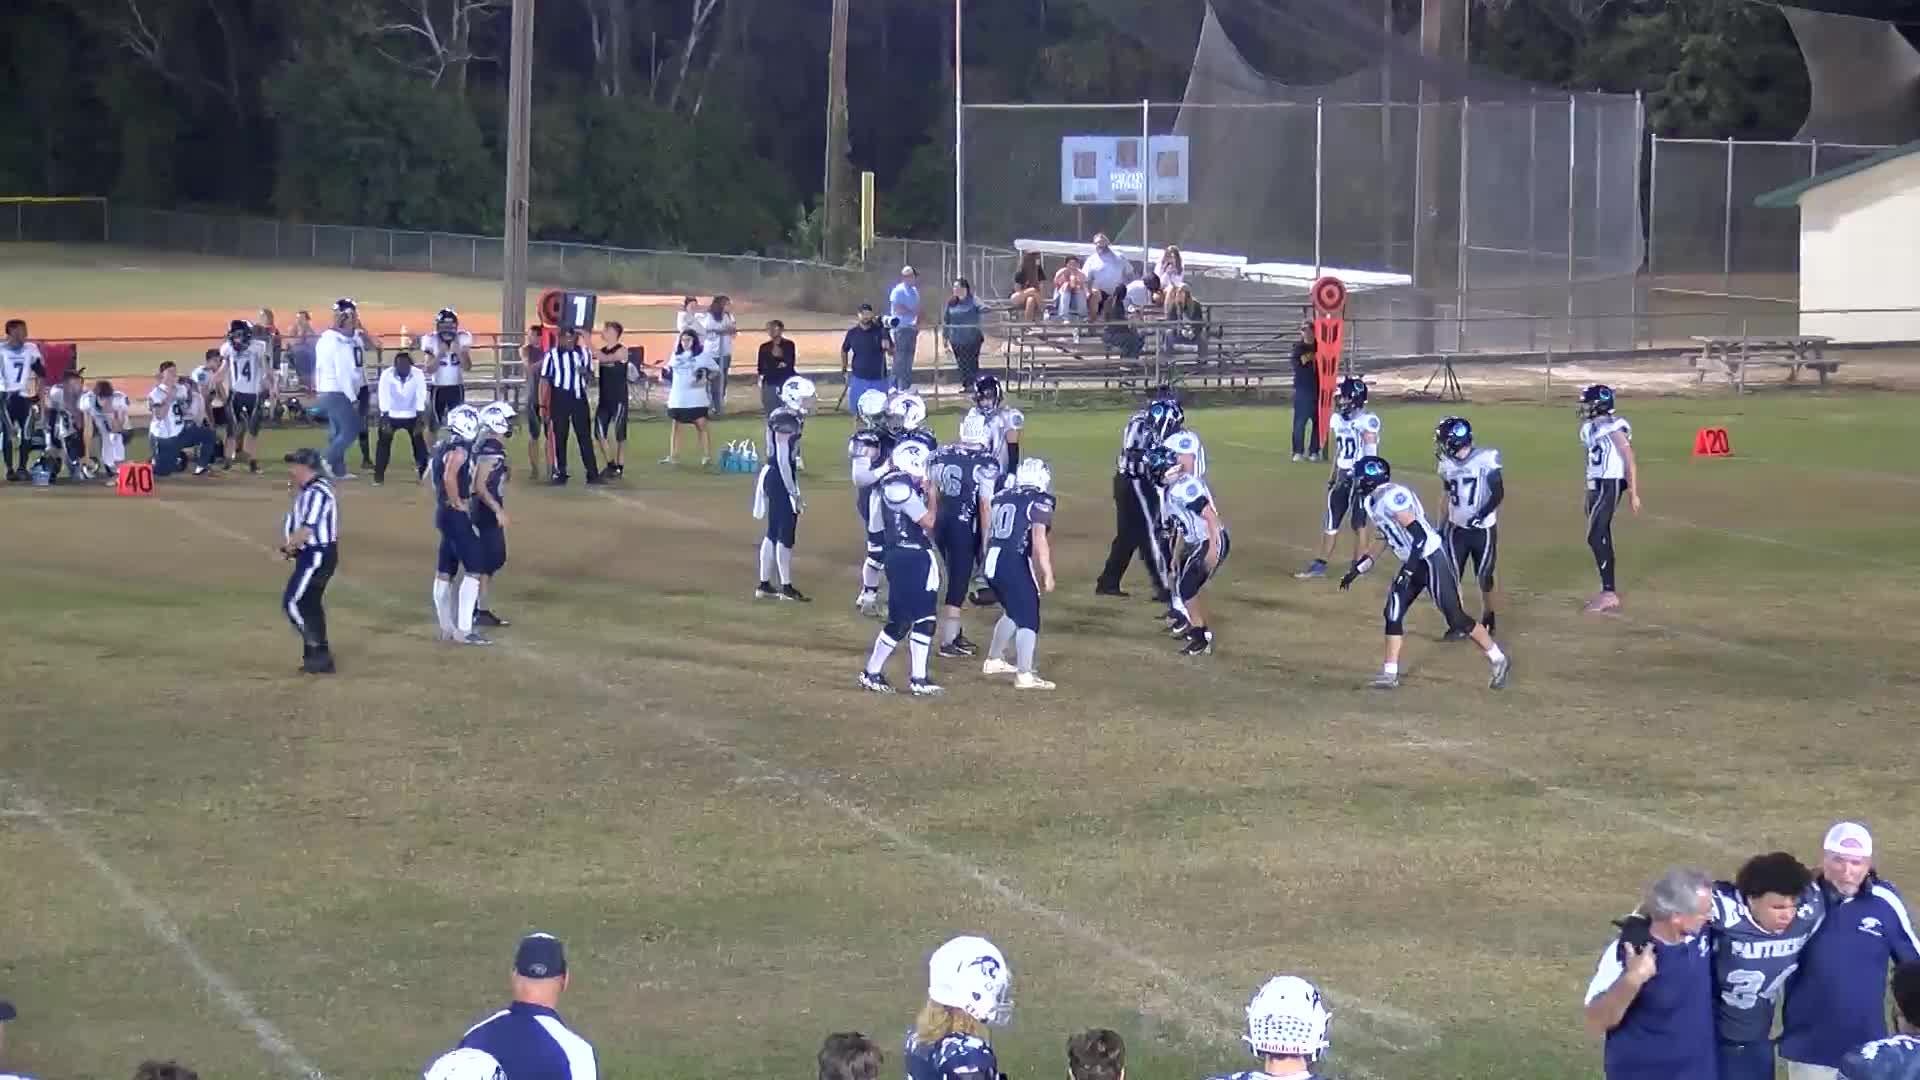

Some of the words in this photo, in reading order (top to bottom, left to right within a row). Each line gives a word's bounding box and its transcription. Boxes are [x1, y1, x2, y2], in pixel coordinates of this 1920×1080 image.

[573, 296, 588, 327] 1
[13, 362, 24, 383] 7
[233, 360, 251, 382] 14
[1706, 428, 1730, 454] 20
[125, 466, 153, 493] 40
